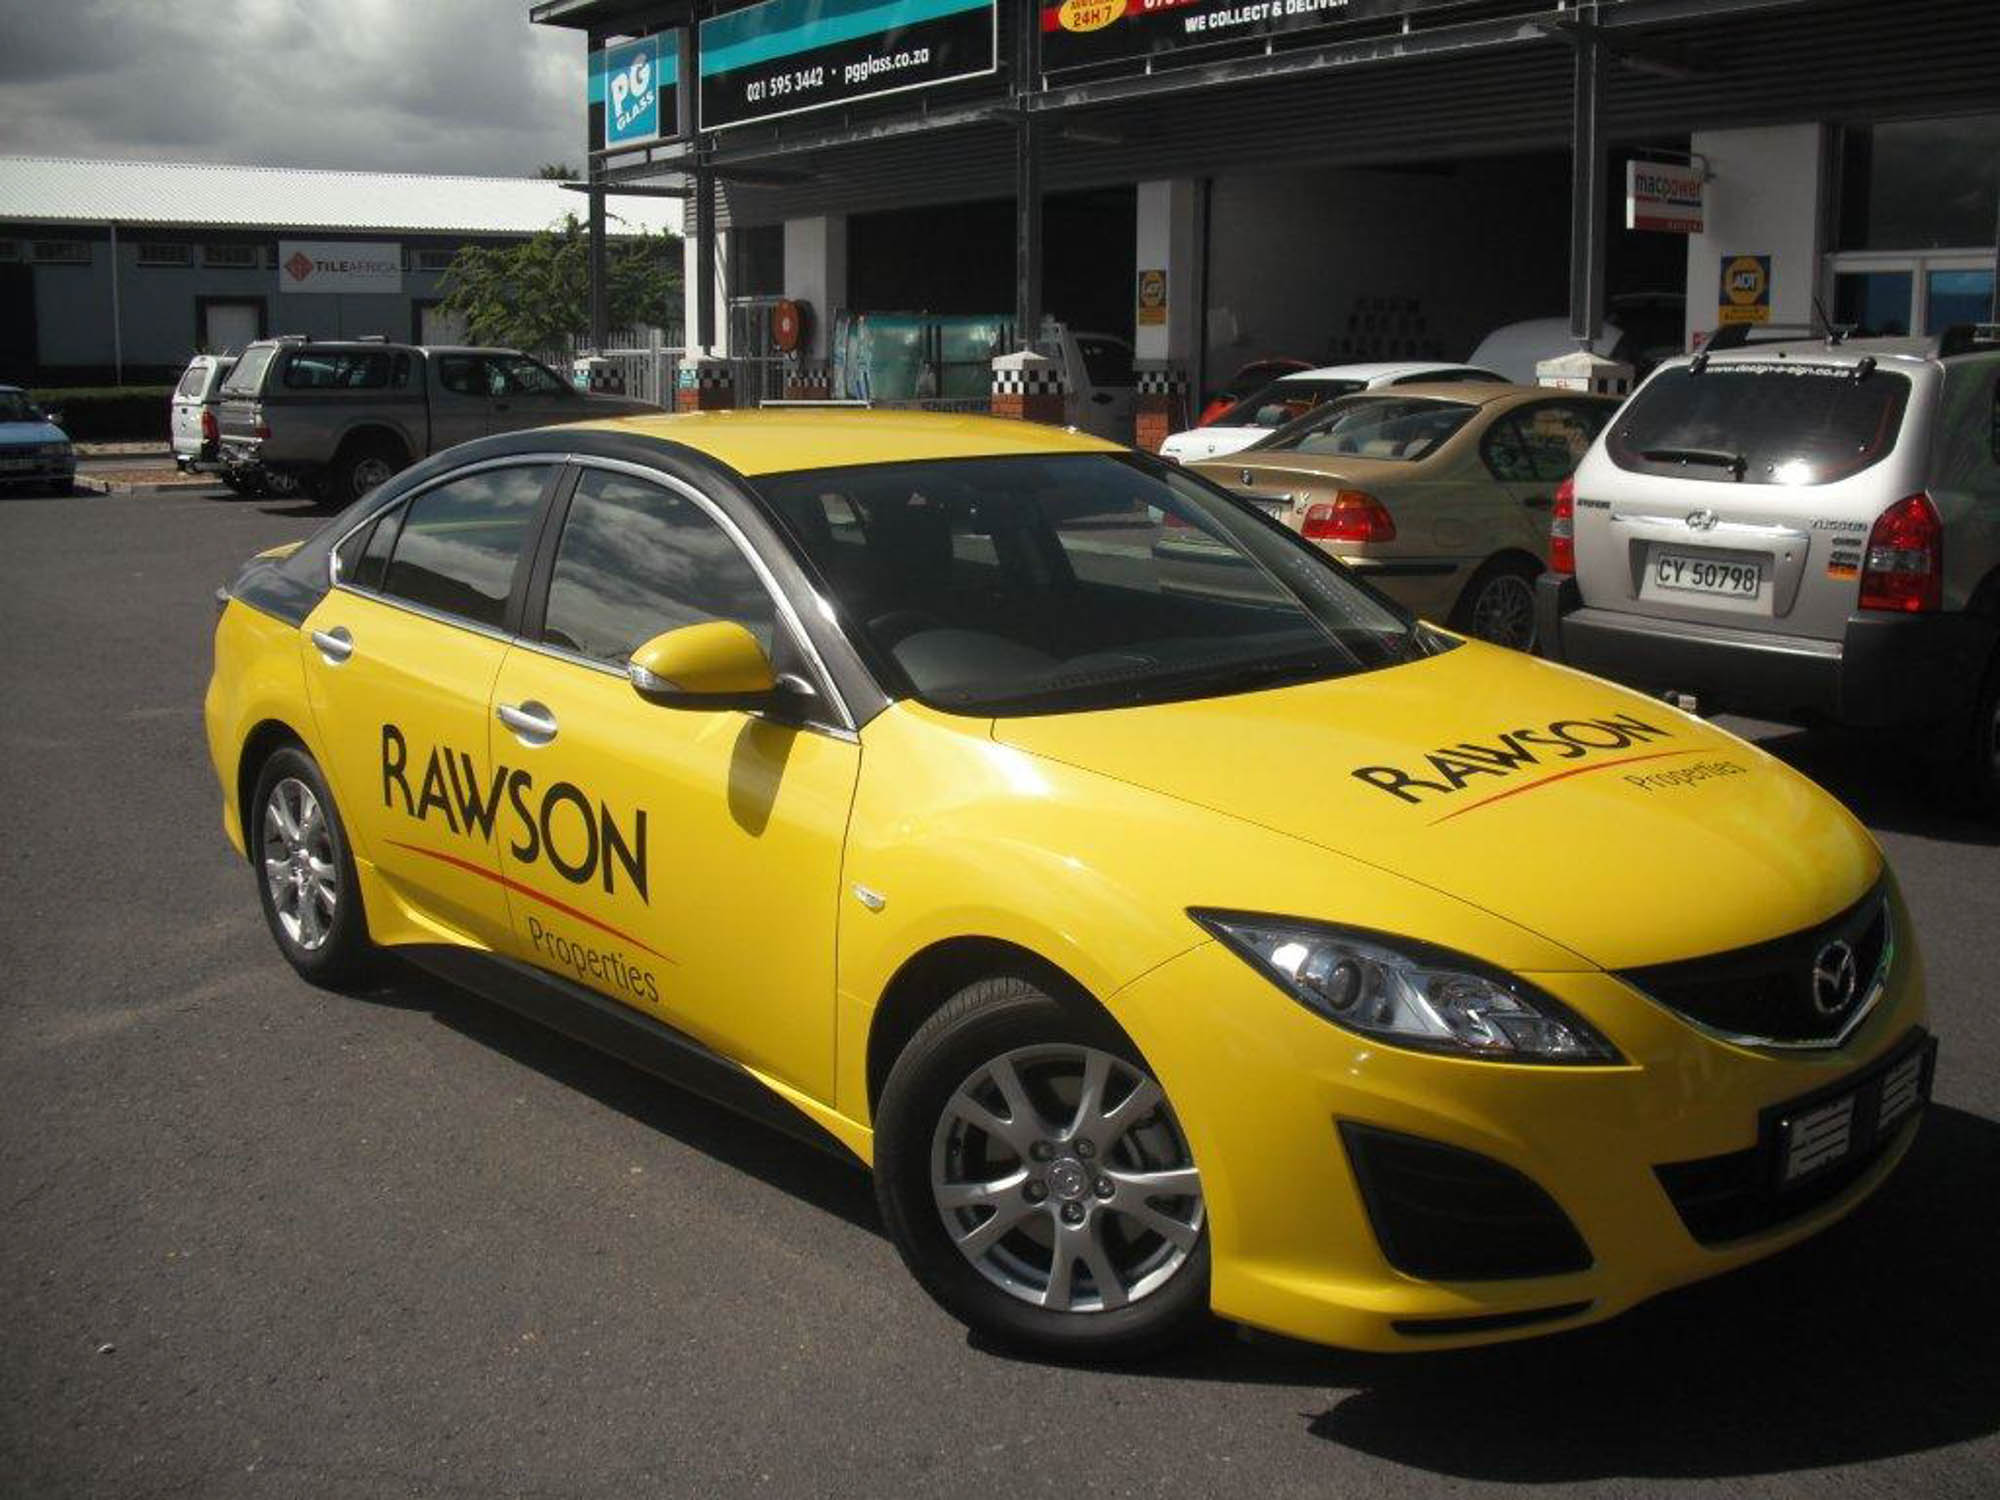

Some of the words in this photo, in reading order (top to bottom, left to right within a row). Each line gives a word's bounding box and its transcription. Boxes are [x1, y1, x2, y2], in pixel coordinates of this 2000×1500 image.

[1184, 15, 1206, 33] WE
[1208, 3, 1269, 29] COLLECT
[1272, 2, 1282, 17] &
[611, 54, 651, 119] PG
[747, 80, 767, 103] 021
[770, 75, 793, 98] 595
[795, 66, 824, 92] 3442
[844, 48, 930, 85] pgglass.co.za
[616, 90, 655, 132] GLASS
[1659, 558, 1686, 583] CY
[1692, 562, 1755, 592] 50798
[1351, 713, 1673, 804] RAWSON
[1623, 760, 1748, 792] Properties
[382, 723, 650, 907] RAWSON
[527, 915, 661, 1003] Properties
